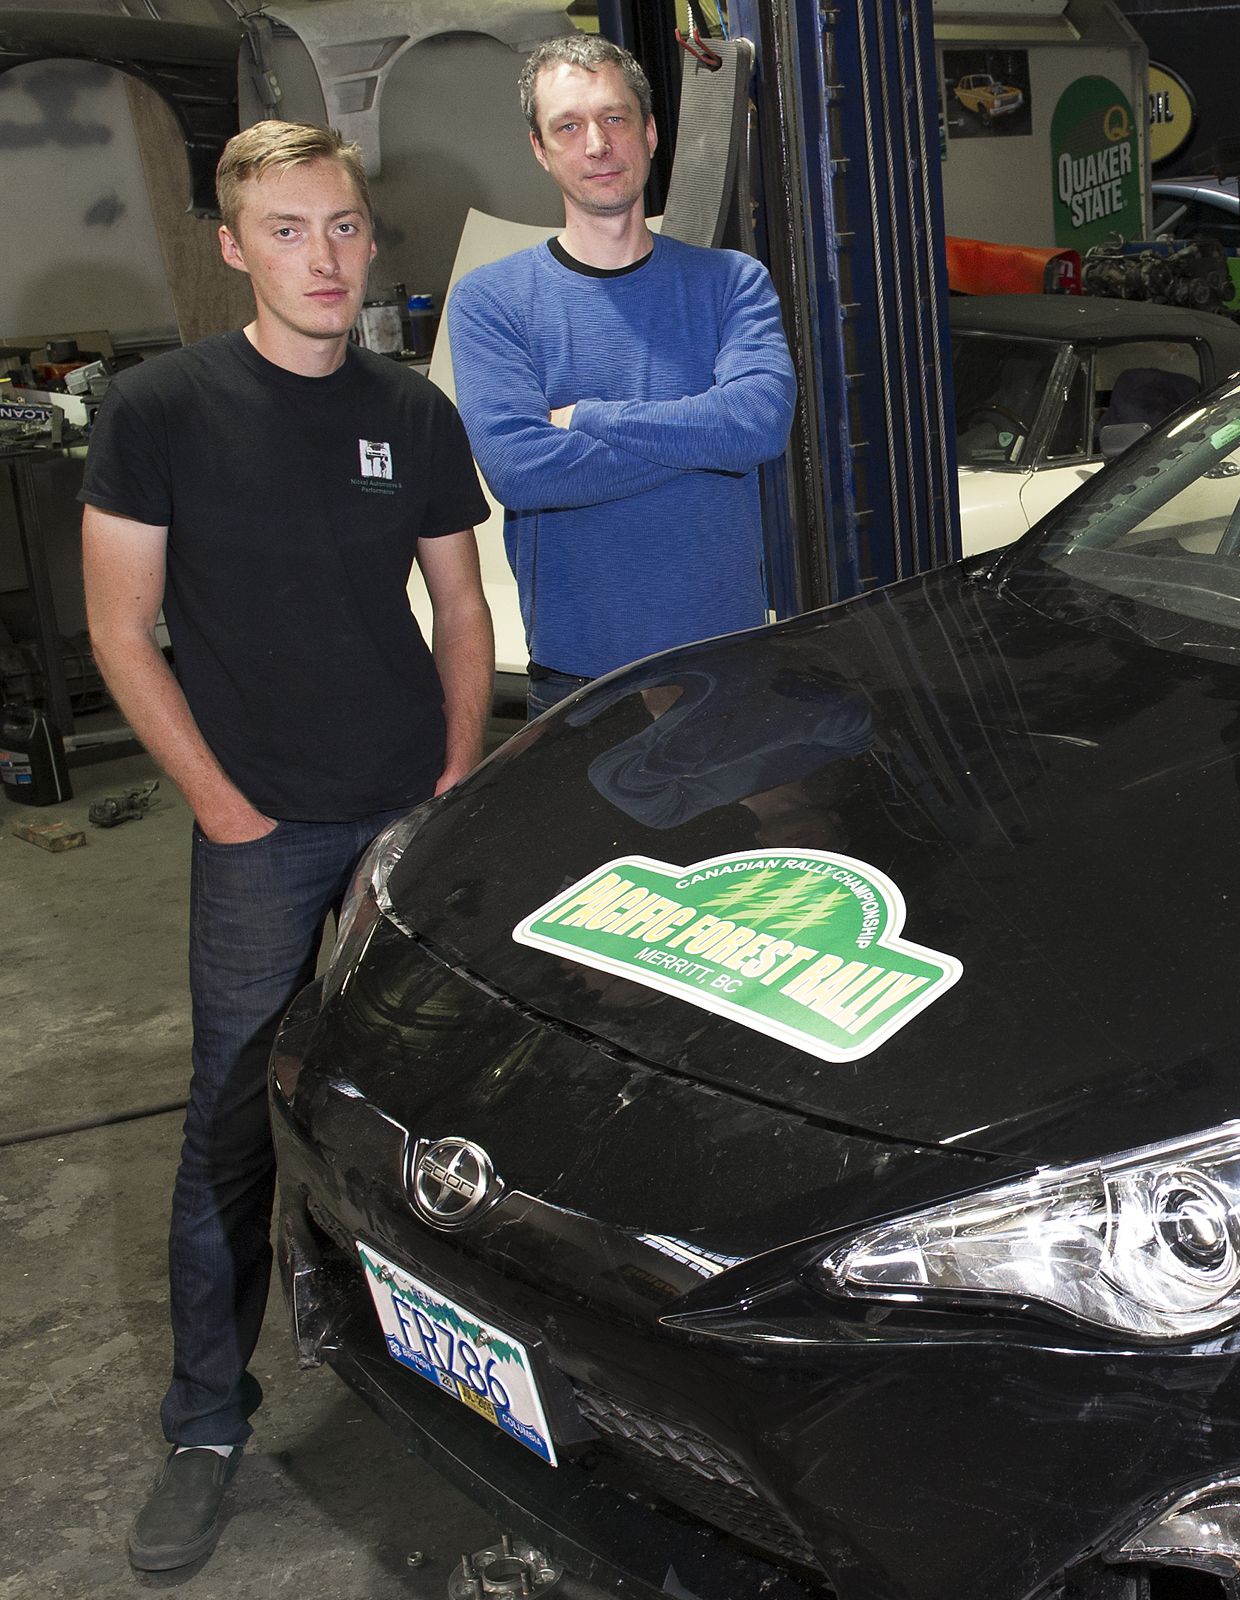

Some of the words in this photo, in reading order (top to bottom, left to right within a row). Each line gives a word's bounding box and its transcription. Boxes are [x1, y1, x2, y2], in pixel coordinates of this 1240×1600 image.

[1058, 142, 1132, 206] QUAKER
[1071, 178, 1123, 228] STATE
[675, 858, 780, 890] CANADIAN
[781, 859, 836, 876] RALLY
[832, 869, 880, 950] CHAMPIONSHIP
[543, 872, 698, 948] PACIFIC
[666, 913, 819, 987] FOREST
[779, 951, 931, 1036] RALLY
[634, 946, 708, 985] MERRITT,
[710, 970, 745, 994] BC
[502, 1413, 543, 1448] COLUMBIA
